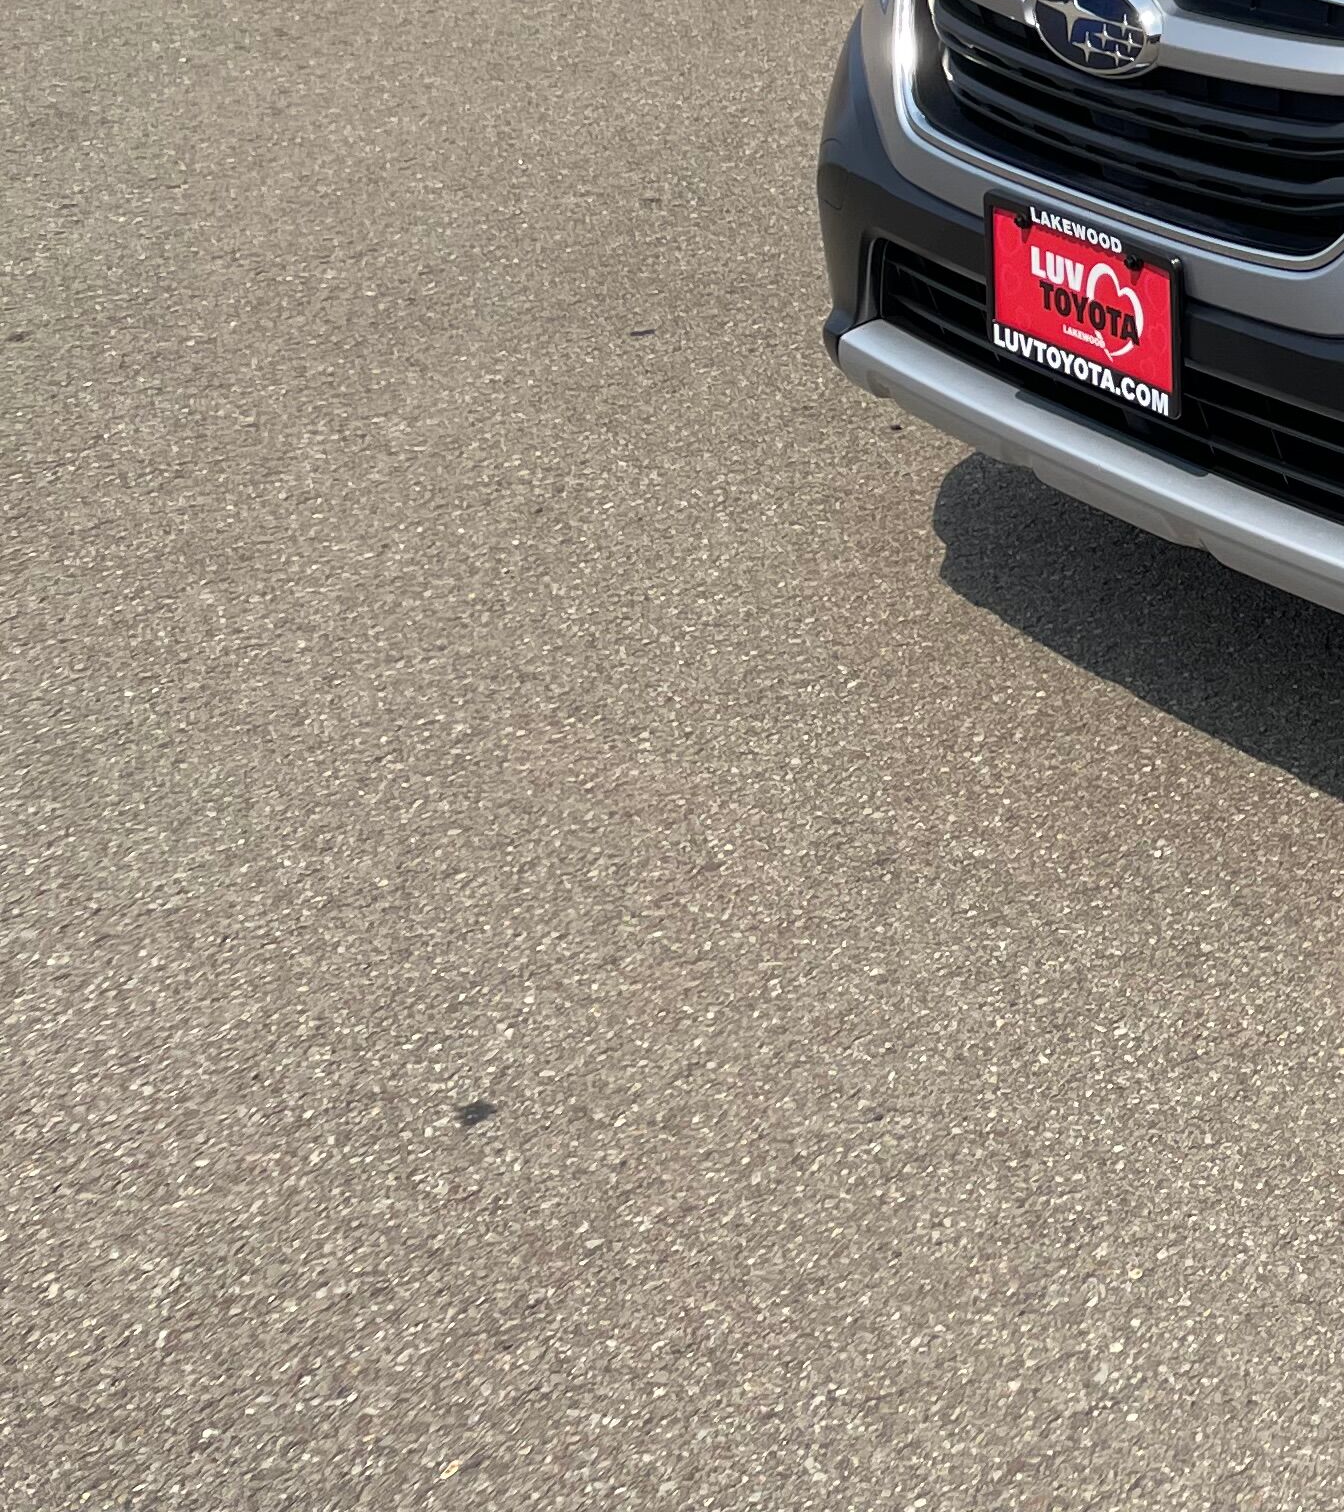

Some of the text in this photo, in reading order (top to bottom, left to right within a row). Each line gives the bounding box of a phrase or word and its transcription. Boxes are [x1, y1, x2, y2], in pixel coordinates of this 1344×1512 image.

[1029, 206, 1122, 254] LAKEWOOD
[1030, 245, 1084, 292] LUV
[1039, 281, 1140, 345] TOYOTA
[1062, 324, 1106, 348] LAKEWOOD
[993, 322, 1169, 416] LUVTOYOTA.COM
